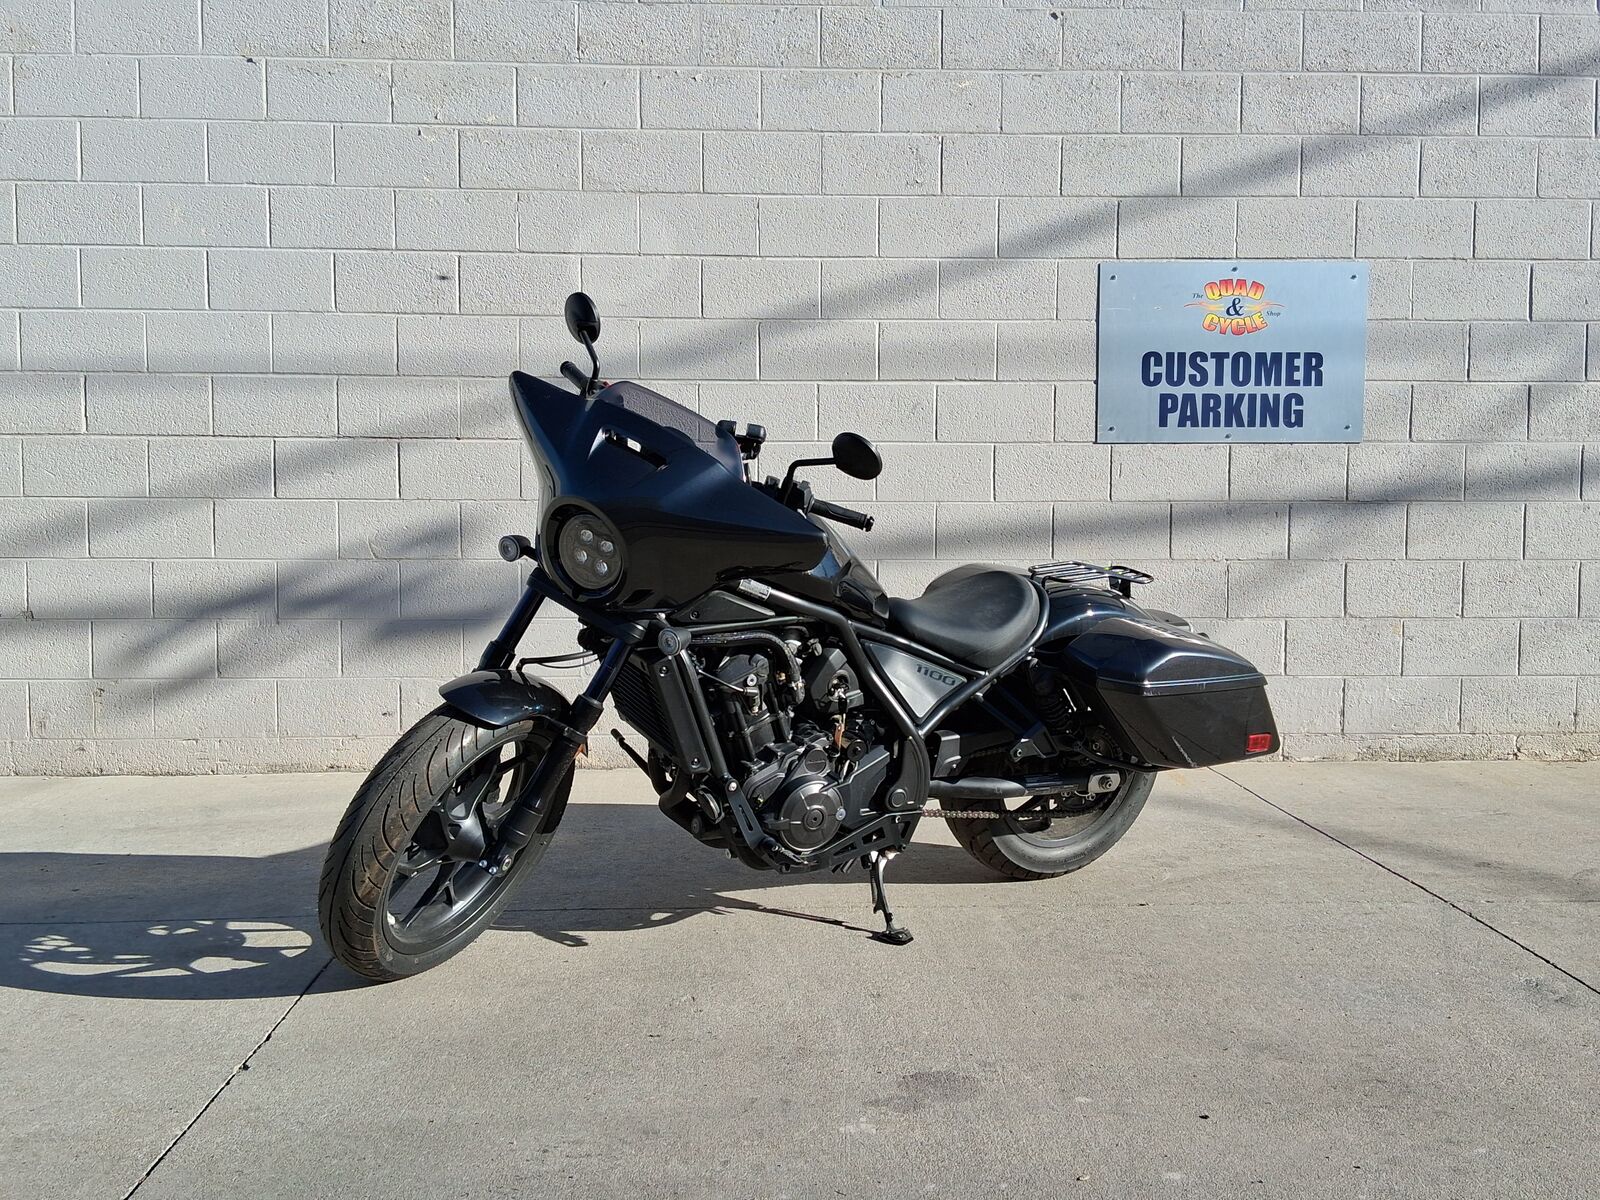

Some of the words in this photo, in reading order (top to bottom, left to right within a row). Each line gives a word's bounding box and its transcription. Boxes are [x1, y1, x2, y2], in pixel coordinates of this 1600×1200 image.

[1204, 279, 1265, 301] QUAD
[1226, 298, 1244, 316] &
[1202, 311, 1268, 335] CYCLE
[1141, 351, 1324, 387] CUSTOMER
[1159, 393, 1304, 428] PARKING
[916, 664, 955, 685] 1100
